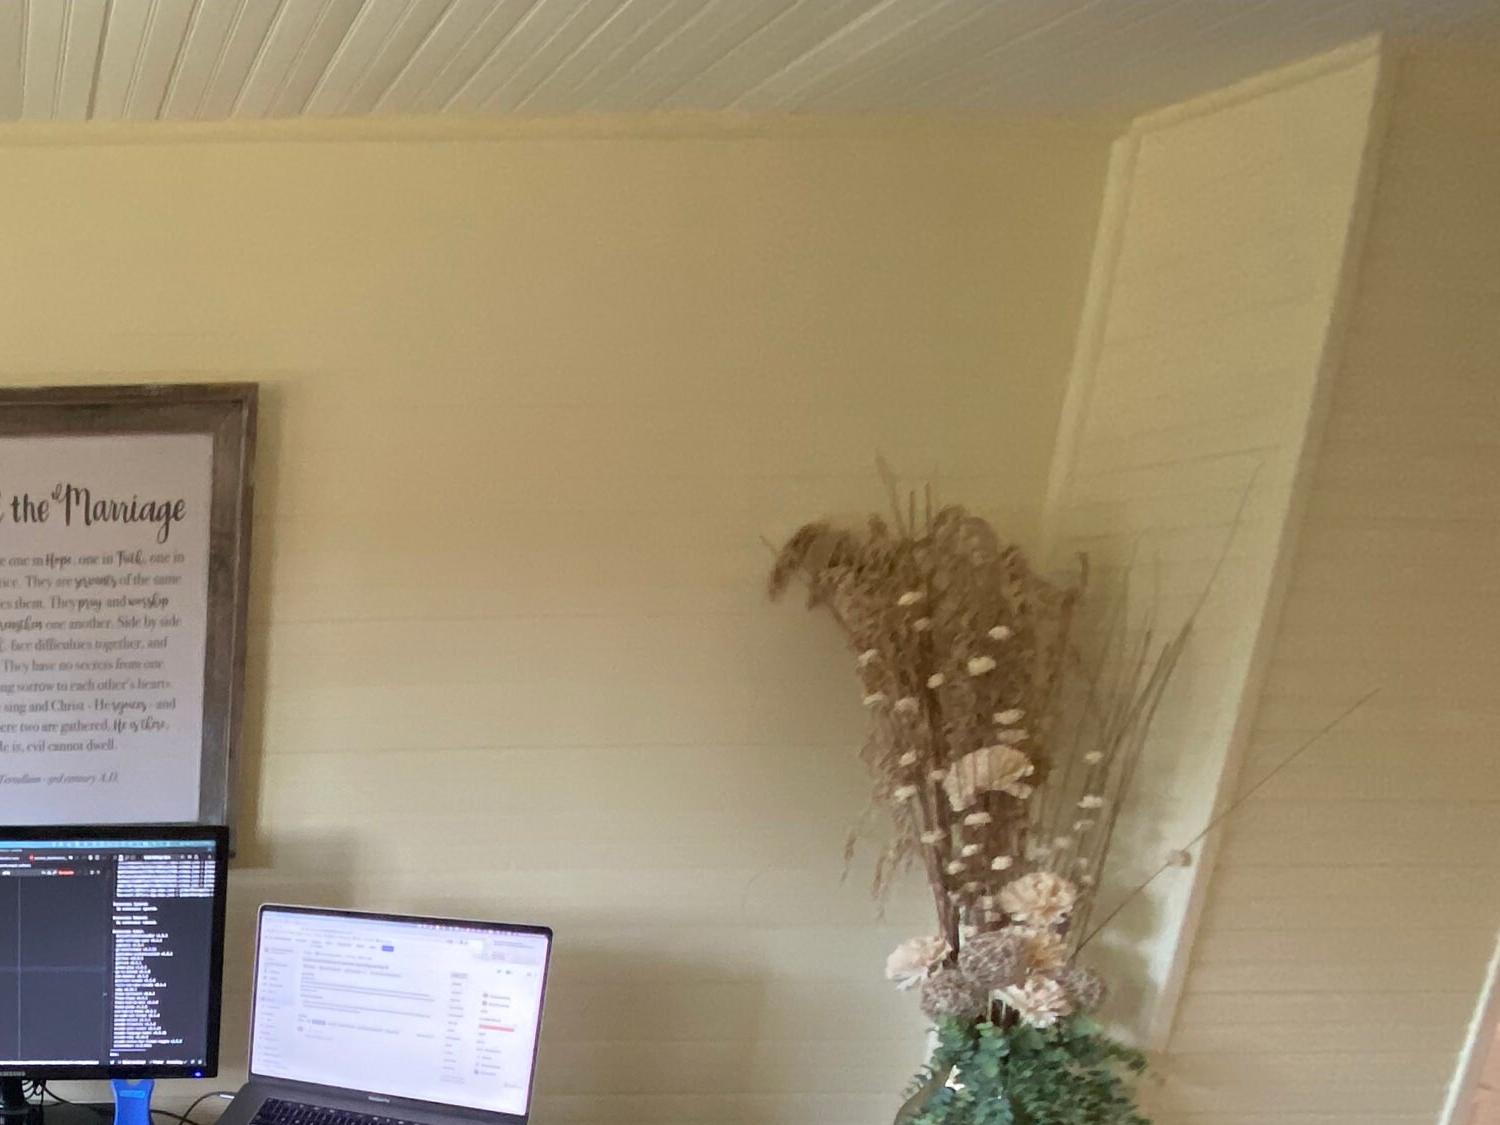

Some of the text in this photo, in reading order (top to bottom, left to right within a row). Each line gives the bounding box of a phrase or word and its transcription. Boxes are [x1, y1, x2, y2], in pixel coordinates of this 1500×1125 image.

[11, 493, 49, 523] the
[52, 483, 187, 544] Marriage
[8, 556, 27, 568] one
[78, 555, 99, 566] one
[102, 553, 114, 565] in
[149, 553, 171, 564] one
[173, 552, 185, 564] in
[25, 574, 52, 589] They
[55, 577, 73, 587] are
[119, 573, 132, 586] of
[133, 572, 150, 586] the
[152, 574, 182, 587] same
[51, 595, 76, 611] They
[106, 595, 127, 608] and
[45, 620, 67, 630] one
[117, 615, 141, 629] Side
[143, 615, 157, 632] by
[159, 613, 182, 628] side
[34, 638, 92, 652] difficulties
[147, 635, 168, 650] and
[3, 658, 28, 674] They
[31, 658, 55, 672] have
[58, 661, 73, 672] no
[74, 660, 114, 671] secrets
[115, 657, 142, 671] from
[142, 660, 164, 670] one
[16, 683, 54, 693] sorrow
[56, 680, 68, 692] to
[70, 678, 95, 692] each
[96, 677, 135, 691] other's
[3, 700, 28, 716] sing
[28, 699, 49, 713] and
[51, 698, 85, 713] Christ
[94, 698, 109, 711] He
[155, 697, 176, 711] and
[19, 722, 40, 733] two
[41, 723, 59, 733] are
[12, 742, 25, 755] is,
[26, 739, 46, 753] evil
[47, 741, 83, 752] cannot
[85, 738, 117, 752] dwell.
